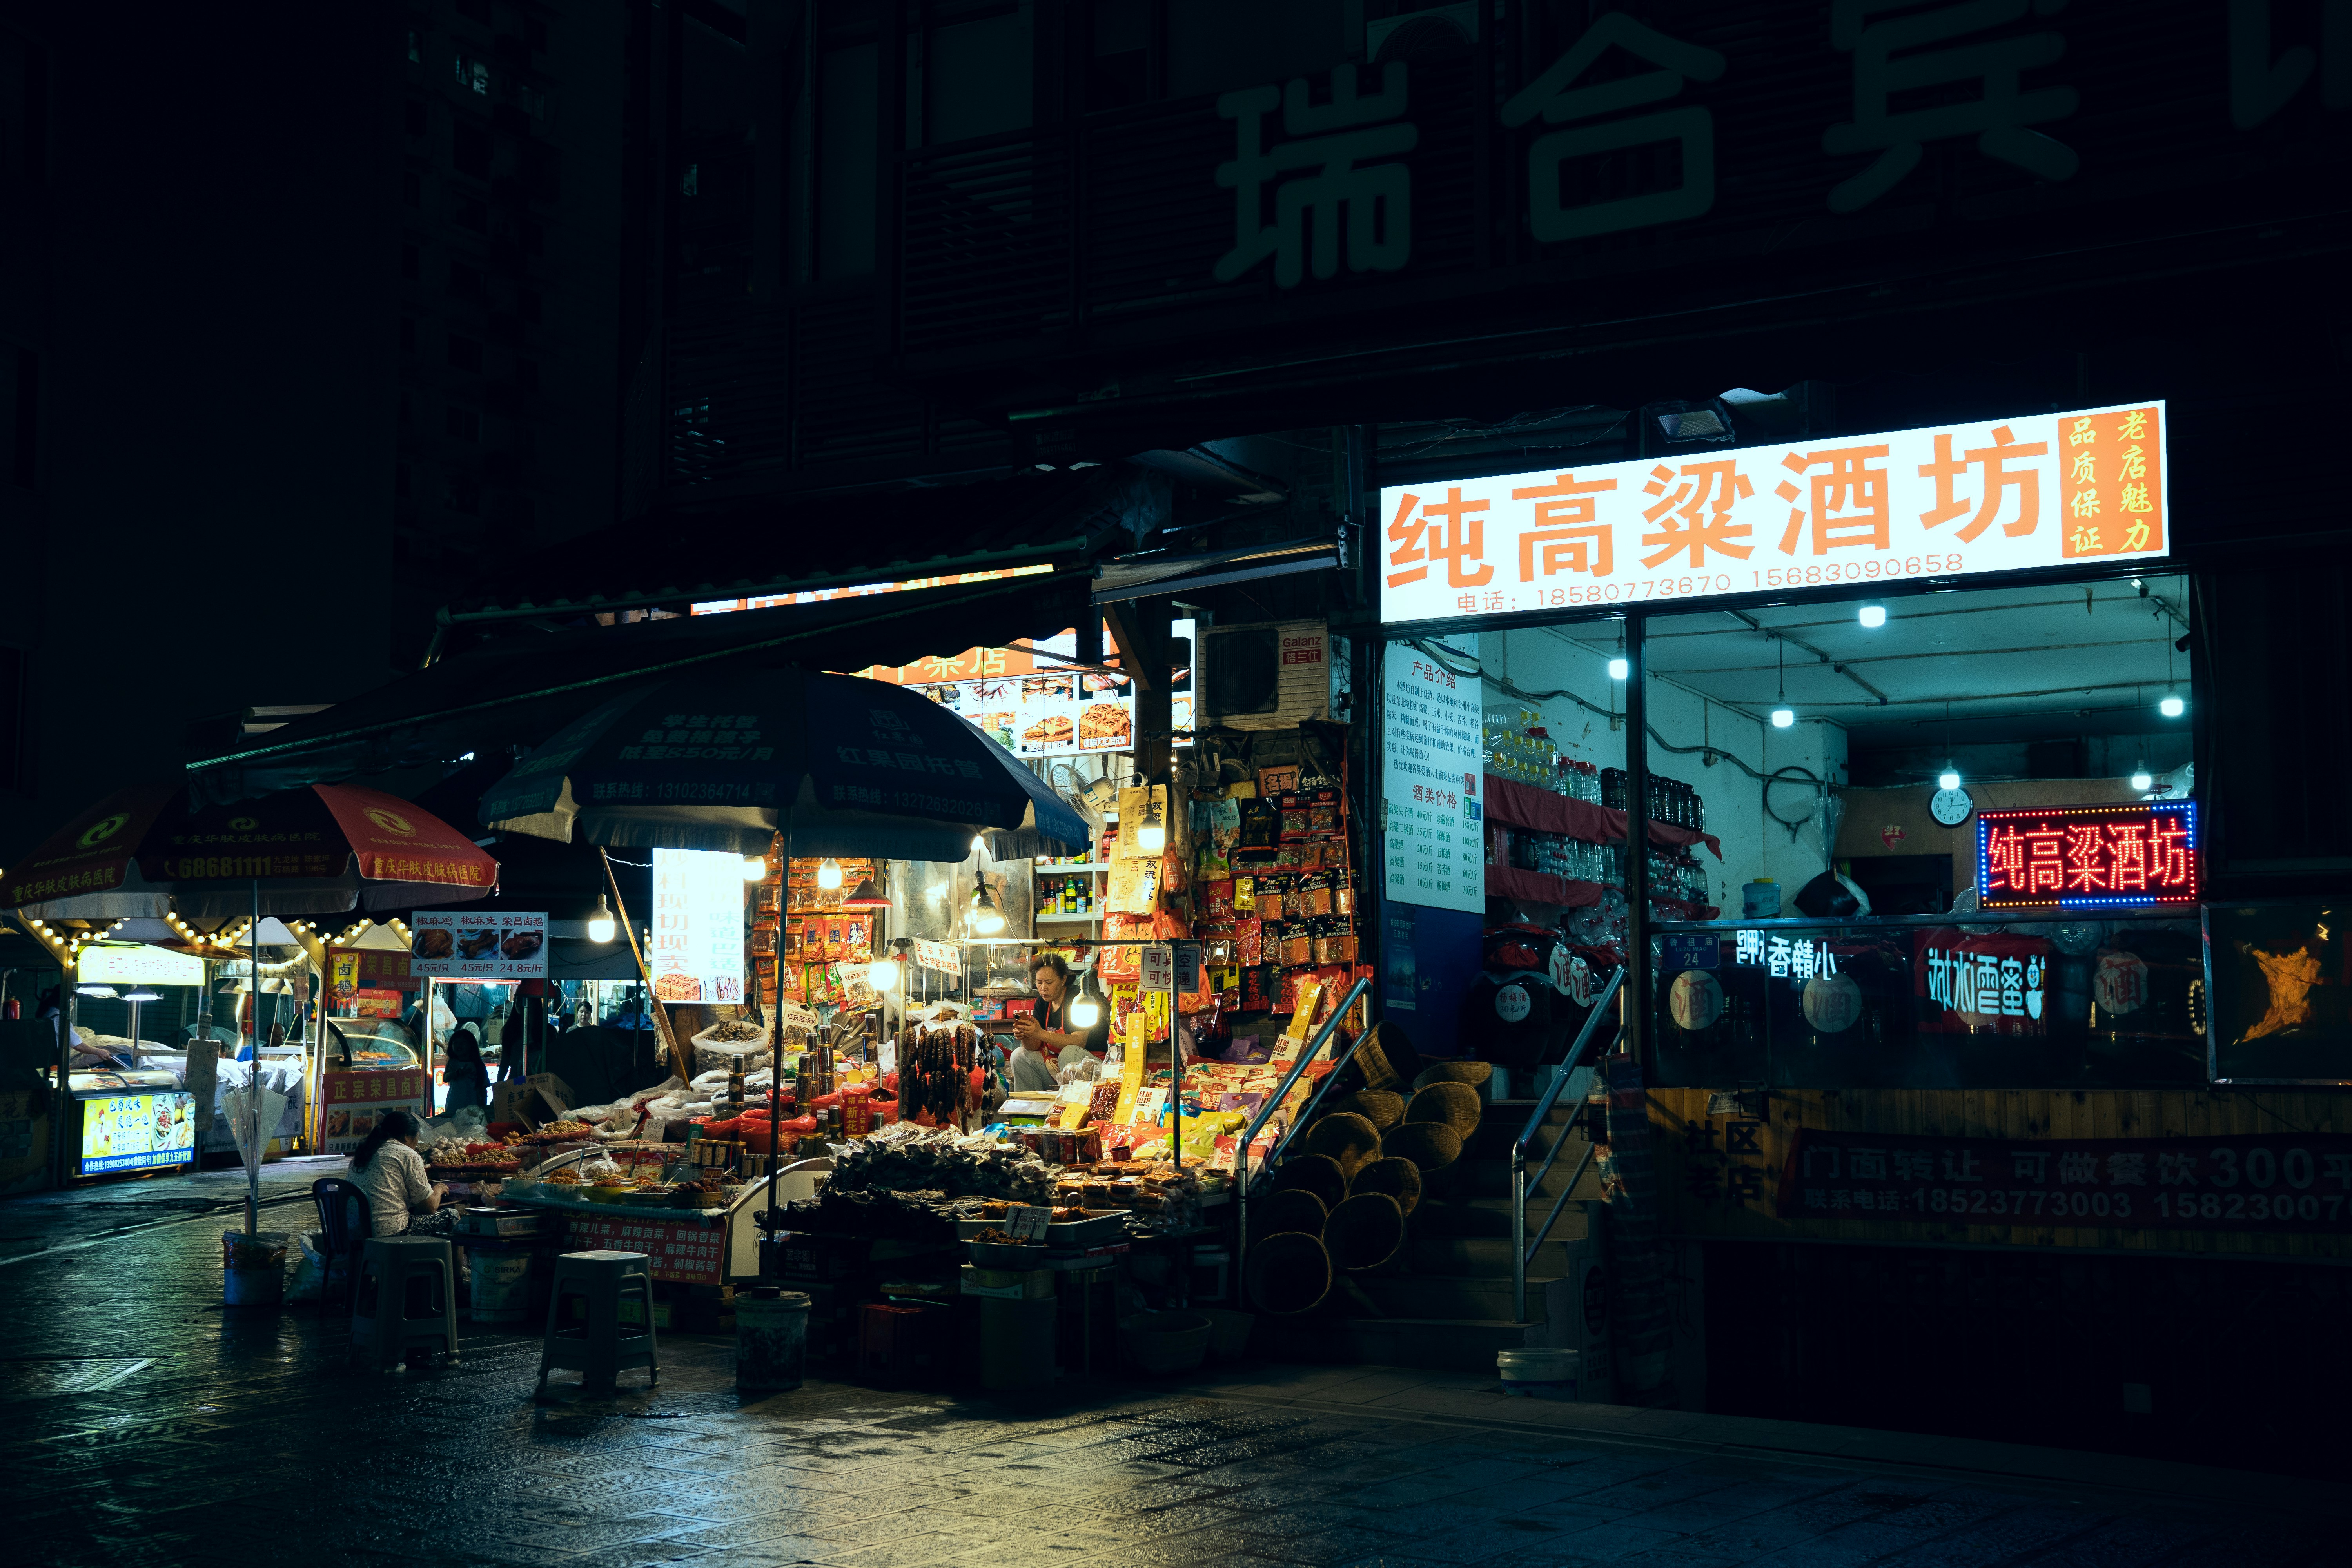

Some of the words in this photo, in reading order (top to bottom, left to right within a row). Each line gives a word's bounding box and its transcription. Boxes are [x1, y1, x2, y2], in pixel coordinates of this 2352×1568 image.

[2069, 417, 2103, 554] 品质保证
[2118, 411, 2153, 552] 老店魅力
[1387, 425, 2048, 588] 纯高粱酒坊
[1538, 574, 1730, 606] 18580773670
[1752, 553, 1963, 587] 15683090658
[1283, 636, 1321, 648] Galanz
[1286, 651, 1319, 664] 格兰仕
[1412, 660, 1455, 689] 产品介绍
[662, 715, 759, 728] 学生托管
[618, 746, 775, 761] 低至850元/月
[837, 746, 984, 779] 红果园托管
[657, 783, 750, 799] 13102364714
[1412, 784, 1457, 809] 酒类价格
[894, 791, 982, 817] 13272632026
[1389, 803, 1413, 818] 高粱头子酒
[1417, 810, 1432, 822] 40元/斤
[1436, 813, 1454, 827] 珍藏窖酒
[1463, 820, 1479, 832] 188元/斤
[171, 831, 321, 845] 重庆华肤皮肤病医院
[1389, 820, 1413, 835] 高粱二锅酒
[1417, 827, 1432, 839] 35元/斤
[1437, 830, 1450, 842] 陈酿酒
[1463, 837, 1479, 848] 108元/斤
[273, 855, 299, 864] 九龙坡
[304, 854, 330, 863] 陈家坪
[1389, 838, 1404, 851] 高粱酒
[1417, 844, 1432, 856] 20元/斤
[1437, 847, 1450, 859] 五粮酒
[1463, 853, 1477, 864] 80元/斤
[1989, 818, 2188, 894] 纯高粱酒坊
[178, 856, 272, 878] 68681111
[274, 865, 299, 874] 石杨路
[374, 857, 482, 882] 重庆华肤皮肤病医院
[1390, 855, 1404, 868] 高粱酒
[1417, 861, 1432, 873] 15元/斤
[1437, 864, 1450, 876] 苦荞酒
[1463, 869, 1477, 880] 60元/斤
[11, 866, 116, 903] 重庆华肤皮肤病医院
[1390, 872, 1404, 885] 高粱酒
[1417, 878, 1432, 889] 10元/斤
[1437, 880, 1450, 893] 杨梅酒
[1463, 886, 1477, 897] 30元/斤
[416, 916, 453, 926] 椒麻鸡
[460, 916, 498, 926] 椒麻兔
[501, 916, 543, 927] 荣昌卤鹅
[657, 851, 688, 972] 炒料现切现卖
[709, 910, 740, 971] 味道巴适
[916, 942, 956, 960] 正宗农村
[1669, 937, 1714, 948] 鲁祖庙
[416, 963, 450, 973] 45元/只
[461, 963, 494, 973] 45元/只
[500, 963, 543, 973] 24.8元/斤
[1149, 953, 1191, 968] 可真空
[1684, 953, 1699, 967] 24
[338, 963, 352, 992] 卤鹅
[1148, 970, 1191, 987] 可快递
[2099, 958, 2141, 1007] 酒
[1499, 991, 1526, 1003] 杨梅酒
[1500, 1005, 1526, 1014] 30元/斤
[1675, 977, 1714, 1022] 酒
[847, 1096, 866, 1105] 精品
[846, 1106, 858, 1135] 新花
[1684, 1119, 1762, 1156] 社区
[1804, 1145, 1984, 1182] 门面转让
[1685, 1164, 1762, 1206] 老店
[2153, 1192, 2352, 1221] 15823007
[495, 1265, 521, 1274] SIRKA
